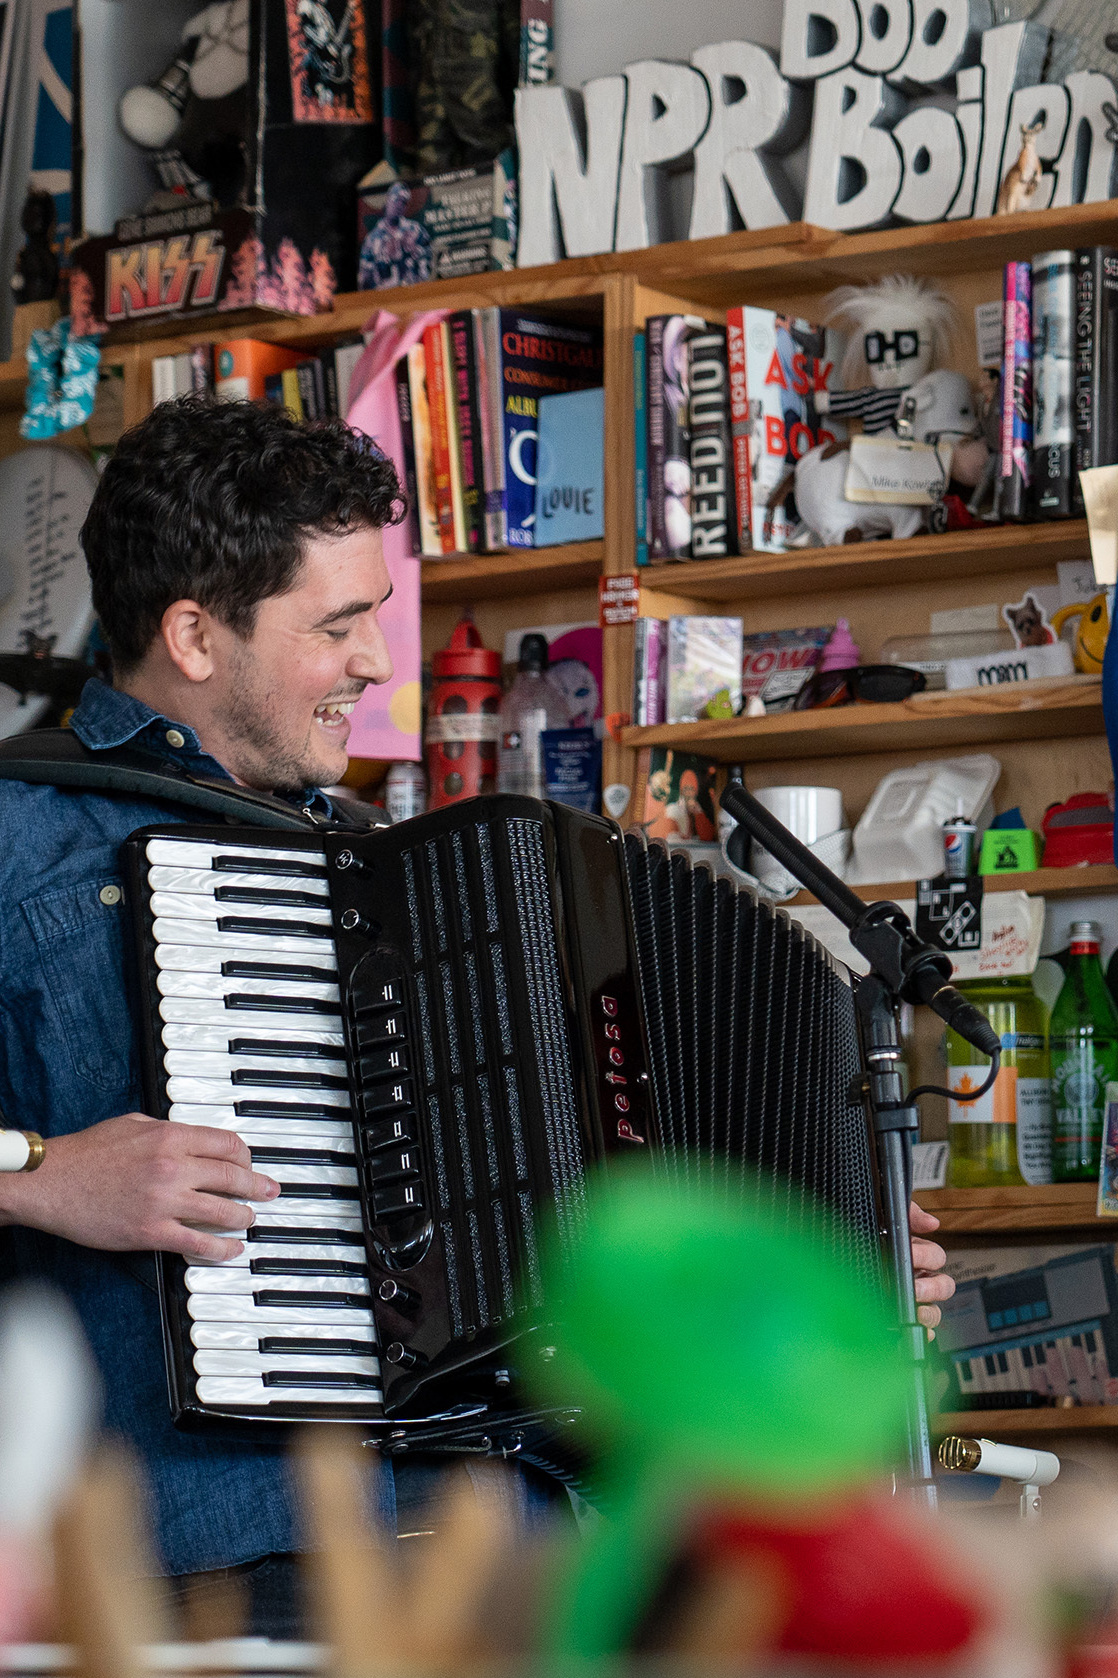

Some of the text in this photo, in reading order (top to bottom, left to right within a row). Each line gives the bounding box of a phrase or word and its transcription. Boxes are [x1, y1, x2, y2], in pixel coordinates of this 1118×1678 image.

[514, 39, 795, 269] NPR
[105, 230, 226, 322] KISS
[1077, 271, 1093, 337] SEEING
[689, 334, 726, 425] LOU
[727, 324, 748, 419] ASK BOB
[764, 349, 834, 395] ASK
[1077, 339, 1092, 372] THE
[1076, 376, 1092, 433] LIGHT
[541, 485, 597, 520] LOUIE
[691, 436, 728, 557] REED
[602, 995, 645, 1143] petosa
